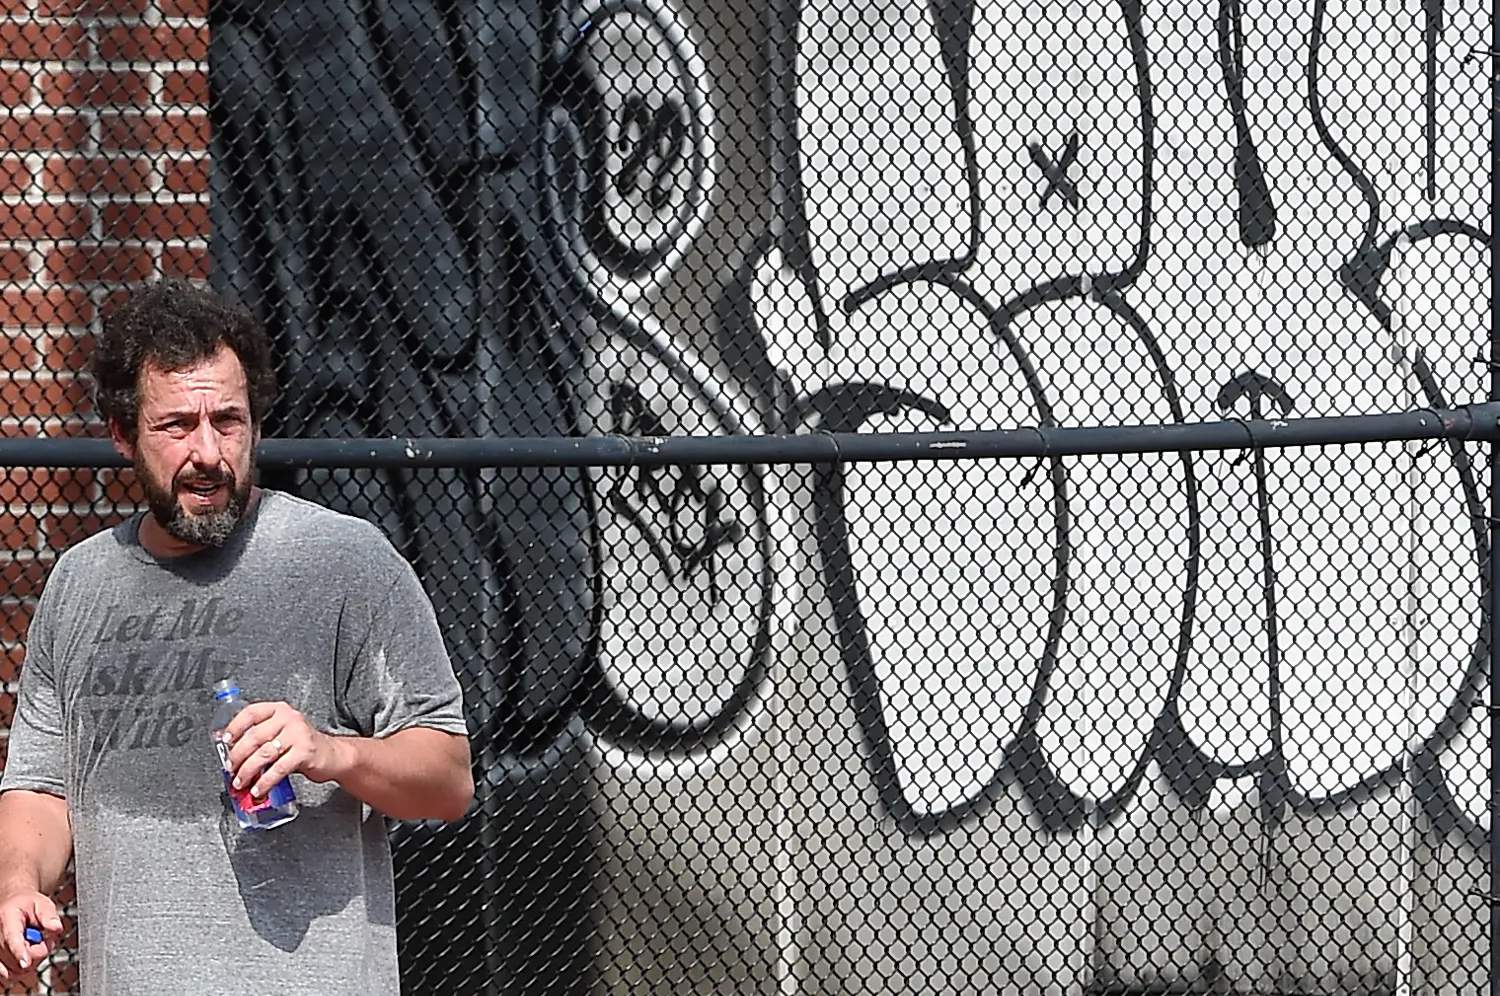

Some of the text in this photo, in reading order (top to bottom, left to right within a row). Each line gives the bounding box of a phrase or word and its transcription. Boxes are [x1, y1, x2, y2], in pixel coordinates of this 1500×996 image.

[91, 597, 244, 643] Let Me
[90, 702, 194, 750] Wife
